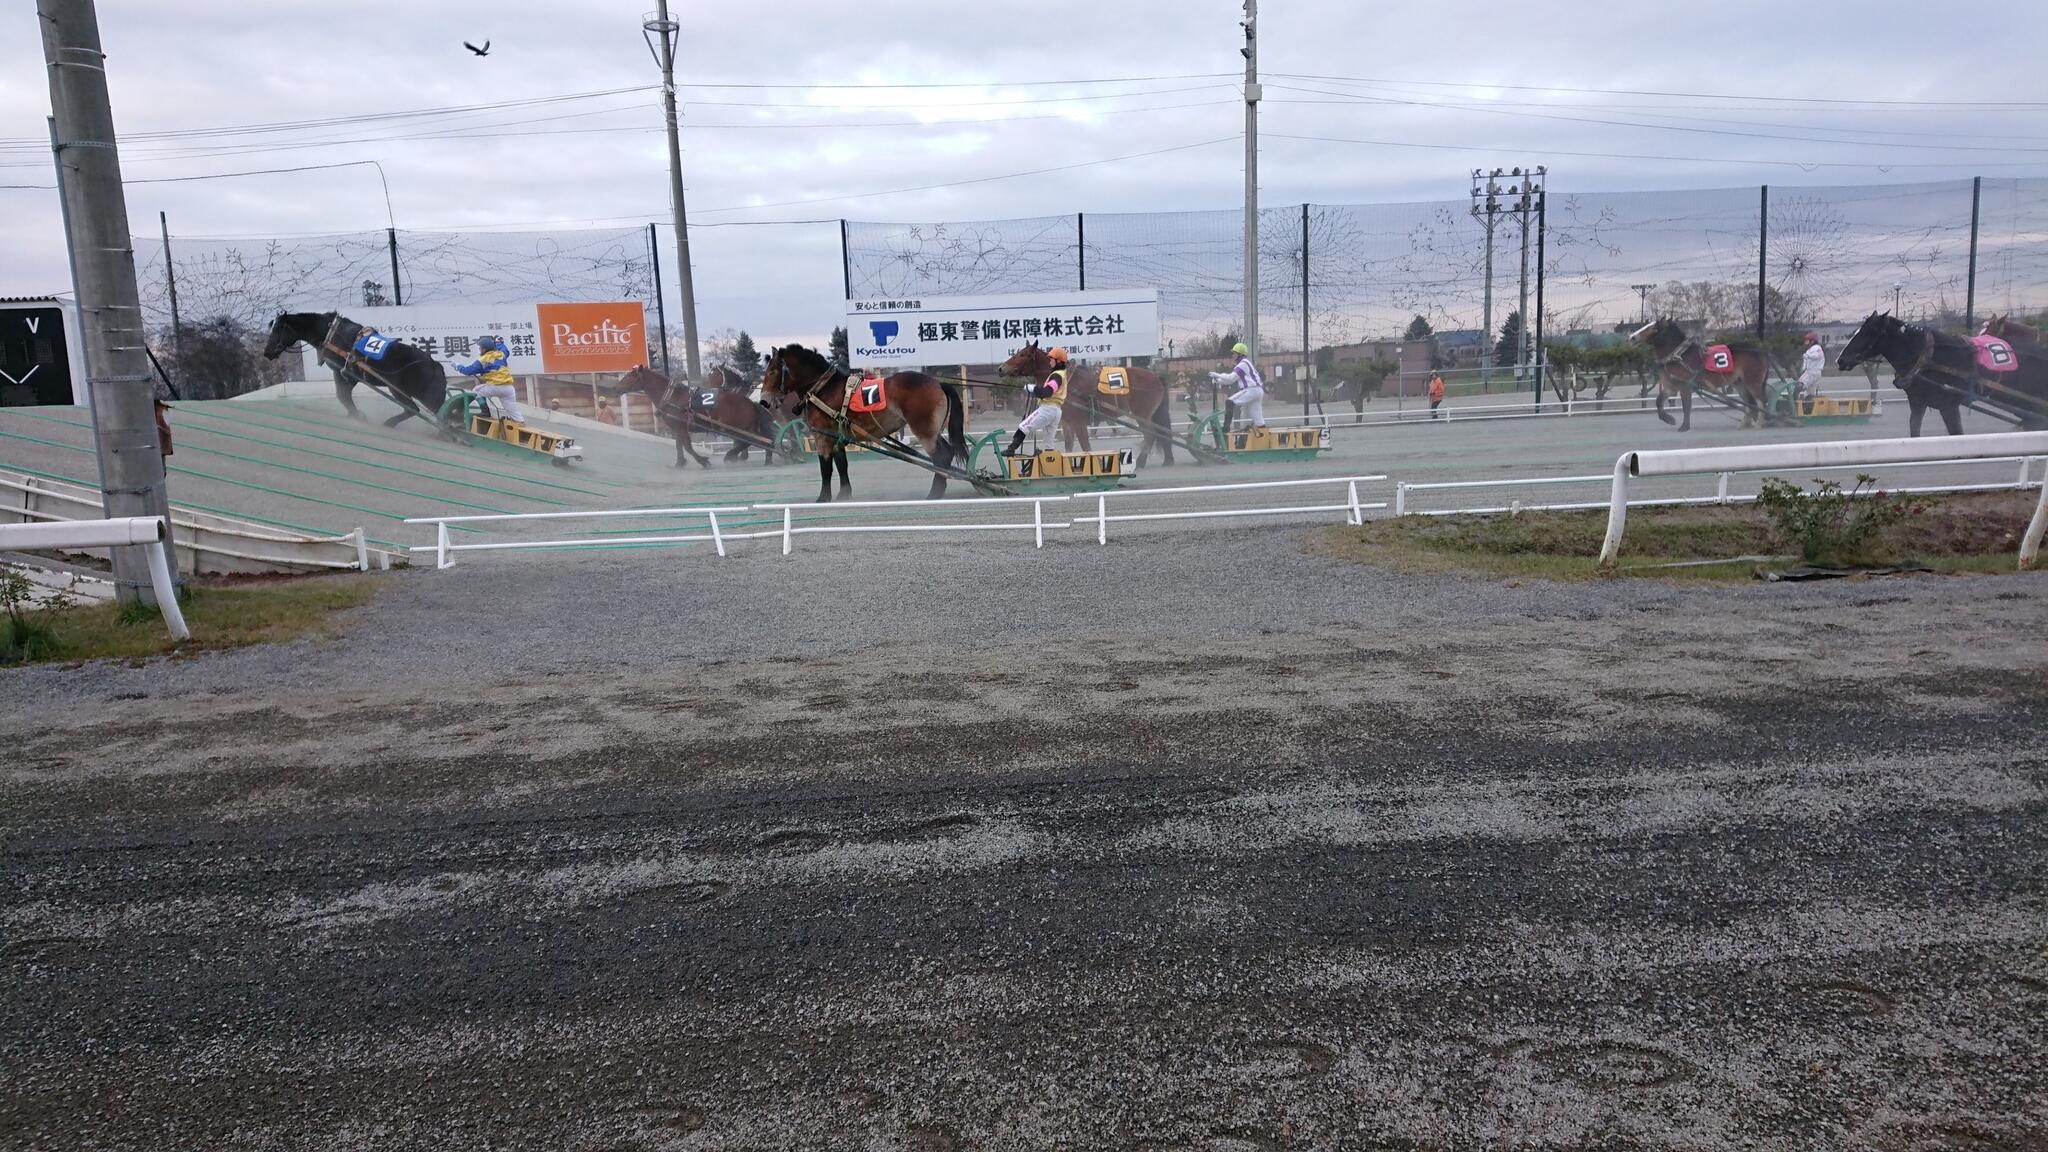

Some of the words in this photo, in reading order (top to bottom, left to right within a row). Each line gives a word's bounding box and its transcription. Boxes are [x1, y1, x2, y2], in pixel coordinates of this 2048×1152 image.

[855, 300, 922, 311] 安心と信頼の創造
[25, 317, 40, 334] V
[487, 321, 533, 331] 東証一部上場
[550, 318, 640, 346] Pacific
[918, 314, 1126, 342] 極東警備保障株式会社
[367, 340, 381, 352] 4
[510, 334, 535, 345] 株式
[511, 345, 536, 357] 会社
[855, 346, 916, 357] Kyokutou
[1988, 343, 2011, 364] 8
[1714, 352, 1729, 368] 3
[1107, 372, 1124, 390] 5
[701, 393, 715, 405] 2
[862, 384, 879, 405] 7
[1320, 428, 1331, 440] 5
[1120, 448, 1132, 465] 7
